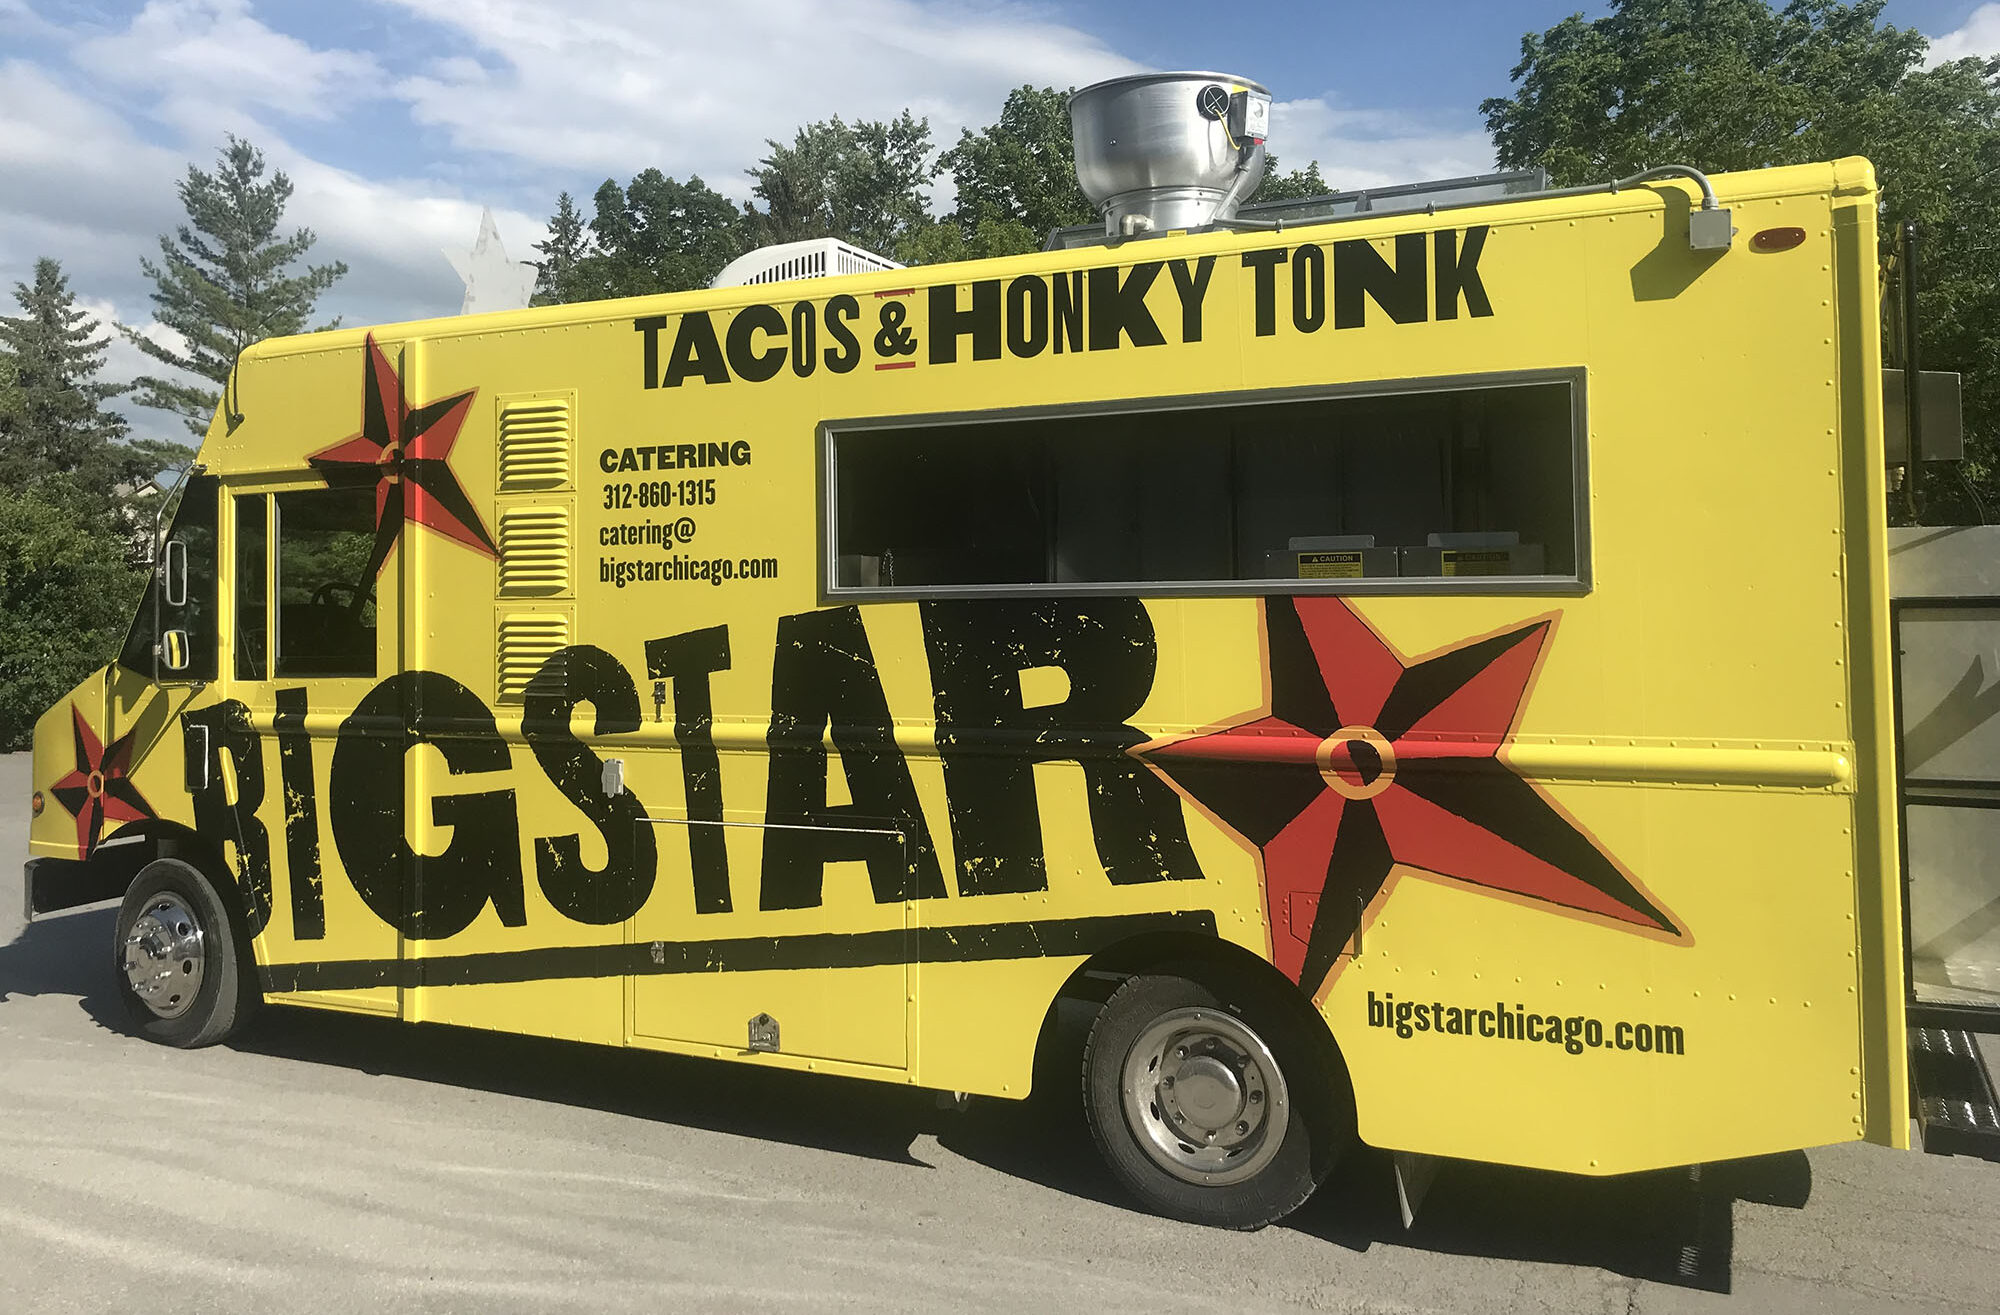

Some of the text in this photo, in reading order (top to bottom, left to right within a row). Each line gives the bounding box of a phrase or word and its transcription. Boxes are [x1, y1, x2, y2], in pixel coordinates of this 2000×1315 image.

[634, 225, 1494, 389] TACOS & HONKY TONK
[600, 440, 751, 474] CATERING
[603, 479, 716, 510] 312-860-1315
[600, 516, 696, 550] catering@
[600, 554, 778, 588] bigstarchicago.com
[1319, 554, 1354, 563] CAUTION
[1367, 990, 1685, 1055] bigstarchicago.com
